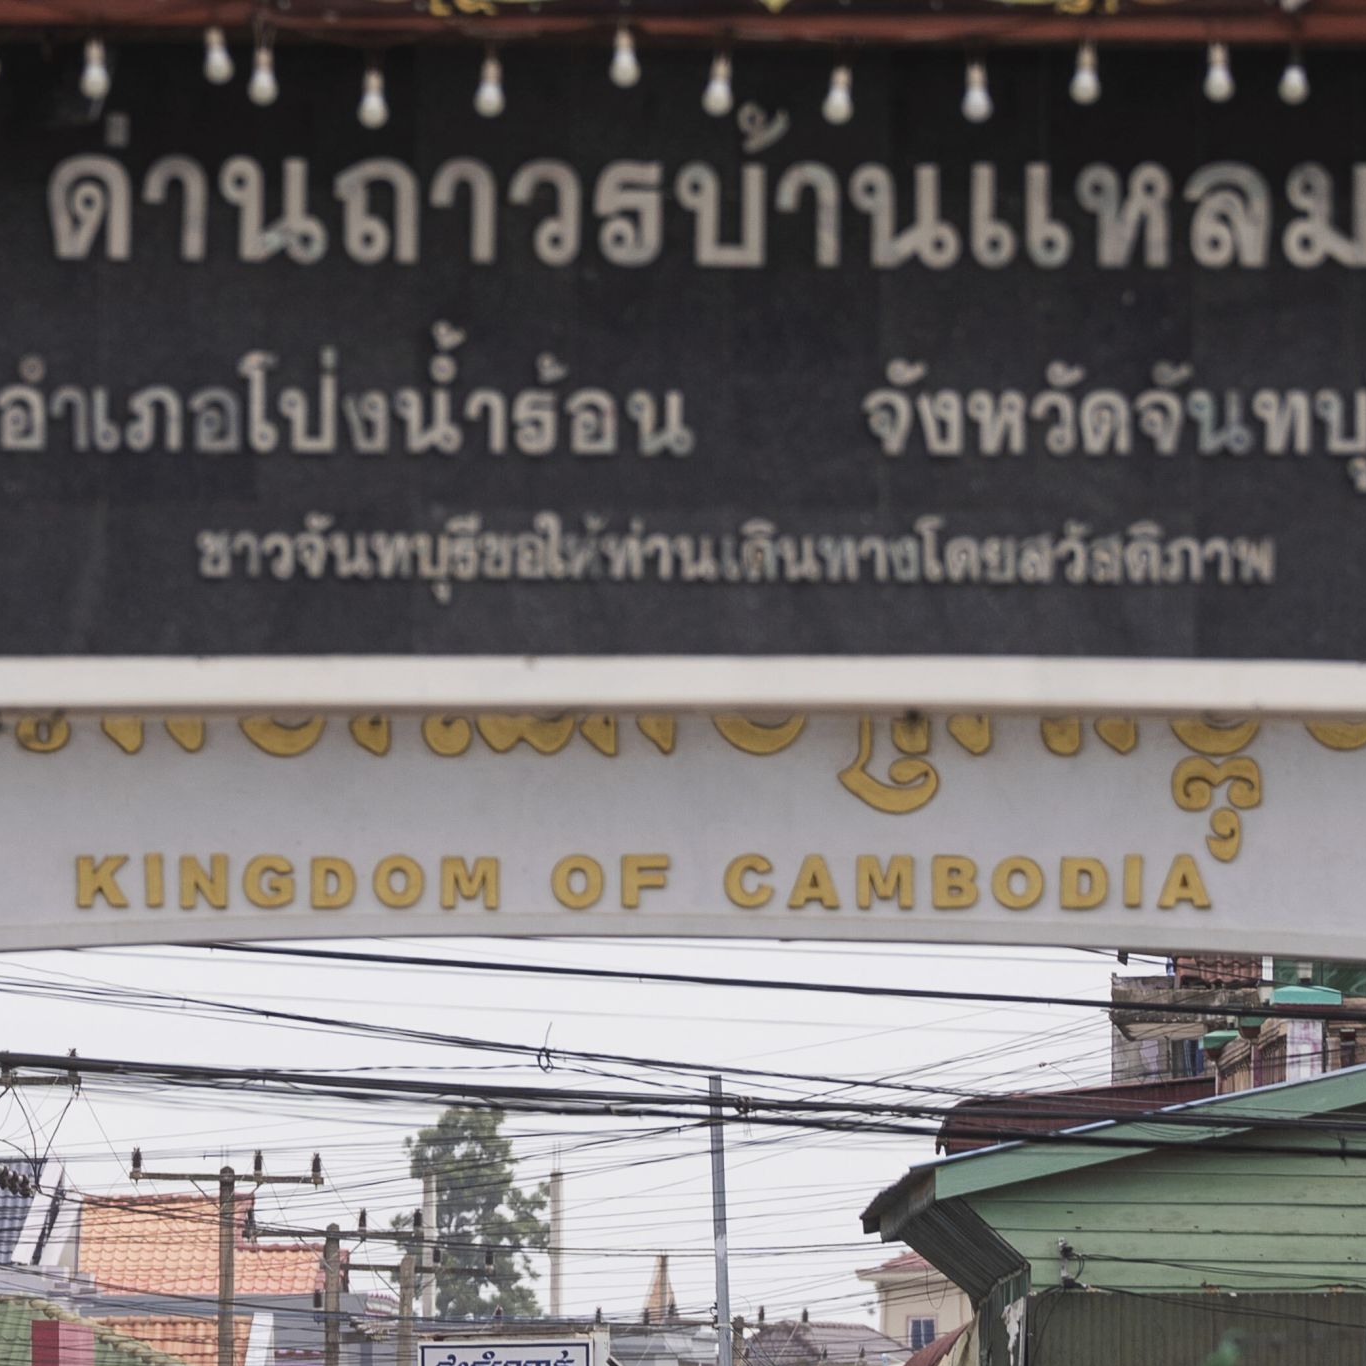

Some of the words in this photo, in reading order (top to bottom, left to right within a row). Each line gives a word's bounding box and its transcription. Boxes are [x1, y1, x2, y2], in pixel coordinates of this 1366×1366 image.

[75, 852, 500, 911] KINGDOM
[550, 853, 670, 910] OF
[723, 853, 1212, 911] CAMBODIA
